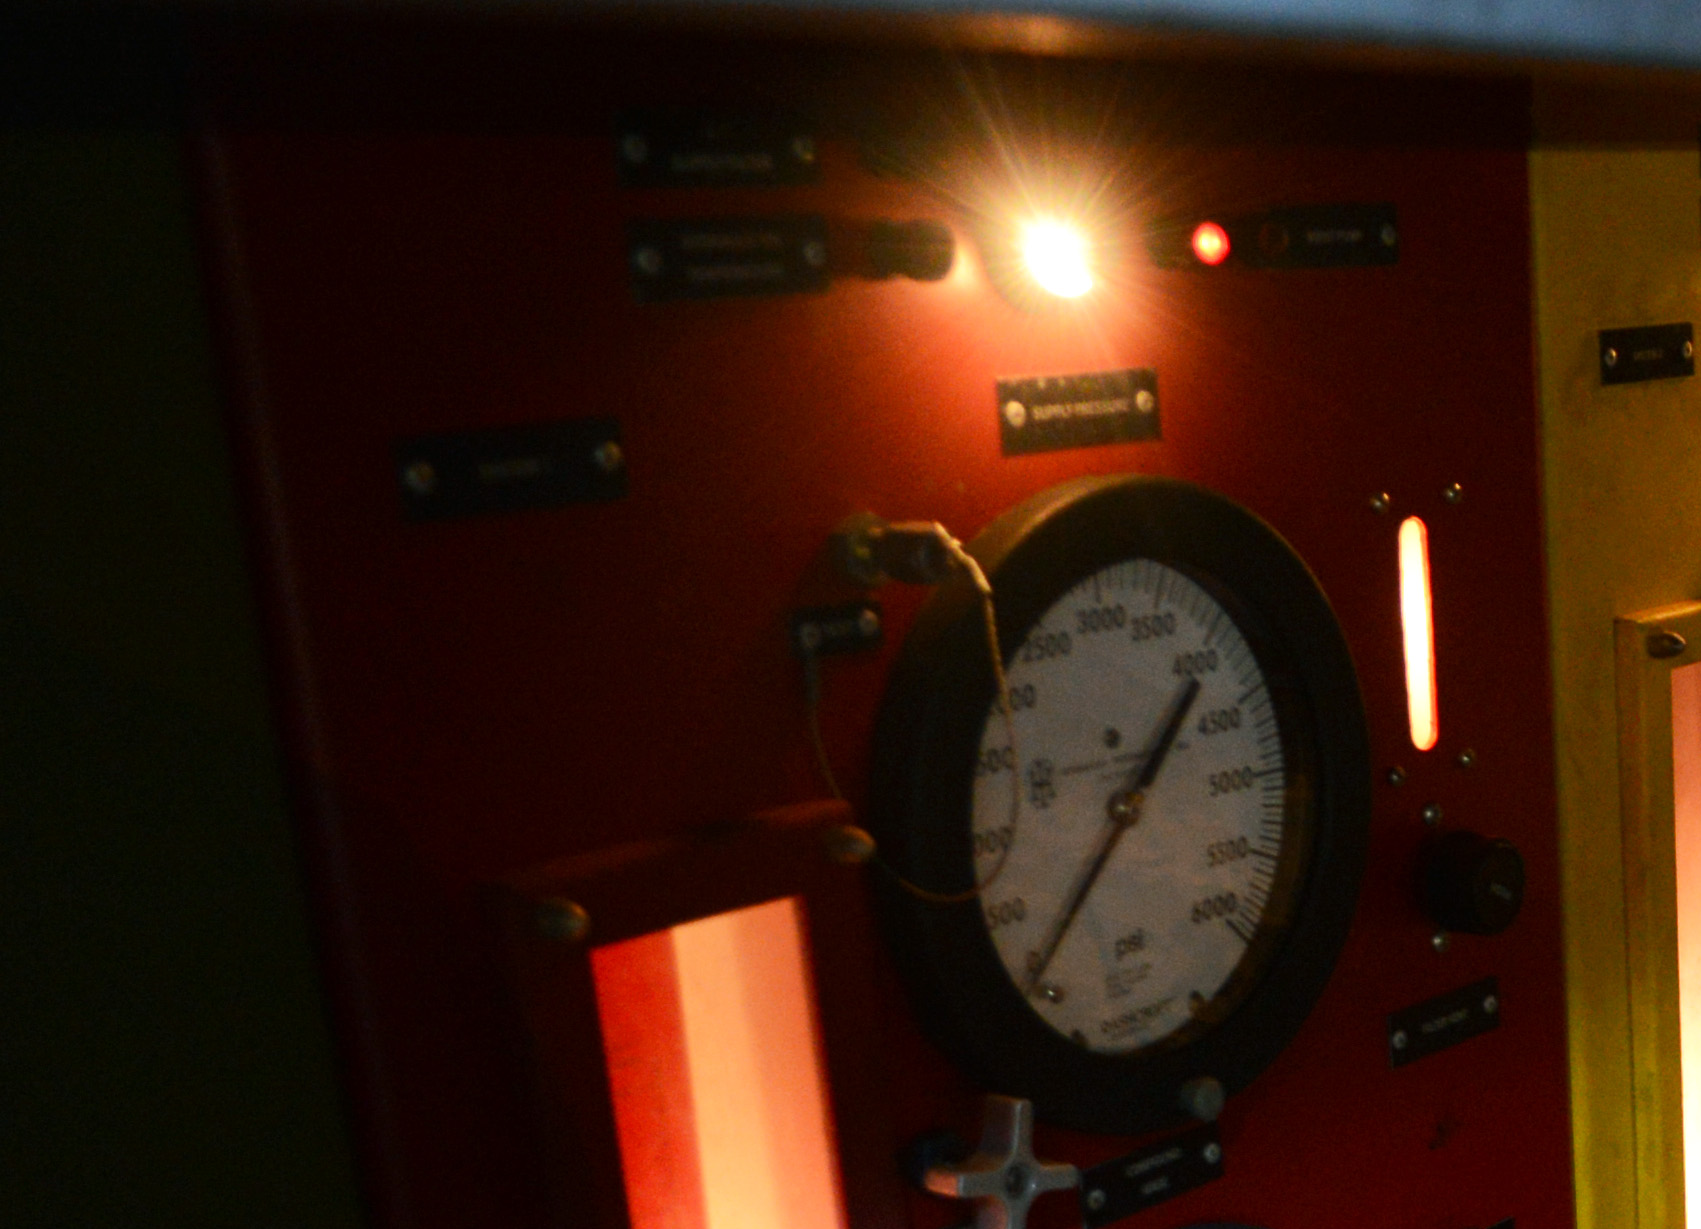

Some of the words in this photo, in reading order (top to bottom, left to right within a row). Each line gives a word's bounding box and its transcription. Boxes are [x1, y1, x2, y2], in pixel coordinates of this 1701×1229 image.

[1077, 603, 1126, 635] 3000
[1131, 611, 1177, 642] 3500
[1022, 630, 1073, 662] 2500
[1172, 648, 1219, 677] 4000
[1198, 706, 1241, 736] 4500
[1209, 766, 1253, 797] 5000
[1207, 836, 1247, 868] 5500
[1191, 891, 1237, 923] 6000
